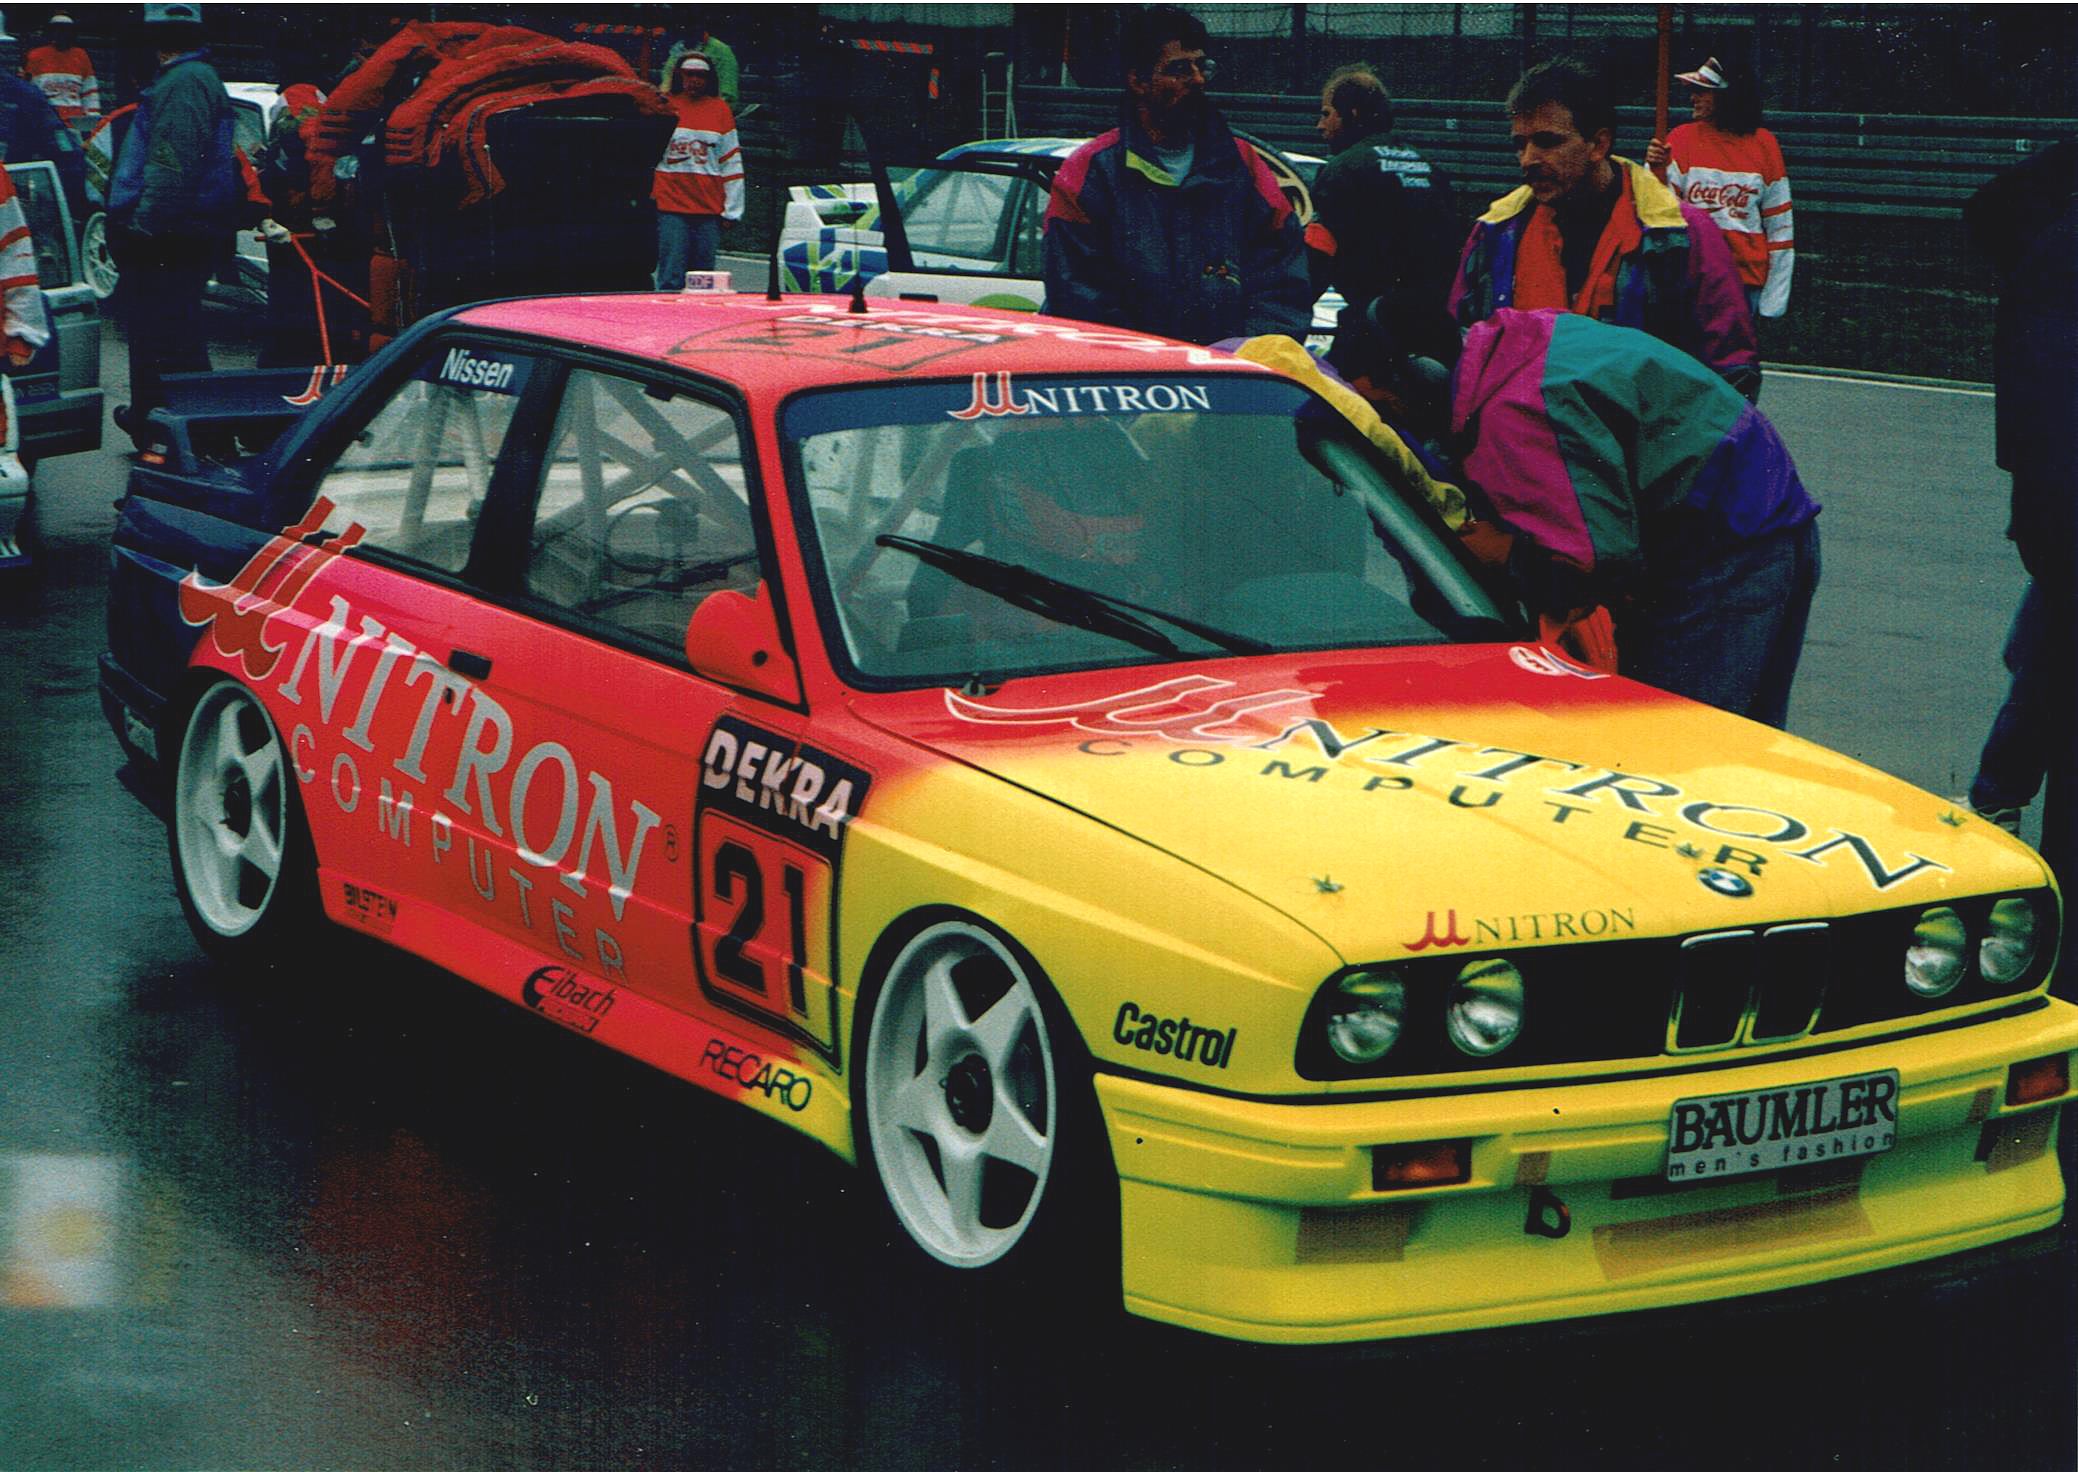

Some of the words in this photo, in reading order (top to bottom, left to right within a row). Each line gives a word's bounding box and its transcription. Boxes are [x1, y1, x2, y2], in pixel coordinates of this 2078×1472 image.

[440, 347, 514, 388] Nissen
[703, 728, 854, 841] DEKRA
[1078, 739, 1768, 877] COMPUTER
[291, 722, 627, 981] COMPUTER
[713, 836, 809, 1020] 21
[522, 966, 616, 1018] Eibach
[1113, 1002, 1237, 1069] Castrol
[701, 1038, 813, 1113] RECARO
[1669, 1150, 1760, 1177] men's
[1783, 1132, 1897, 1162] fashion
